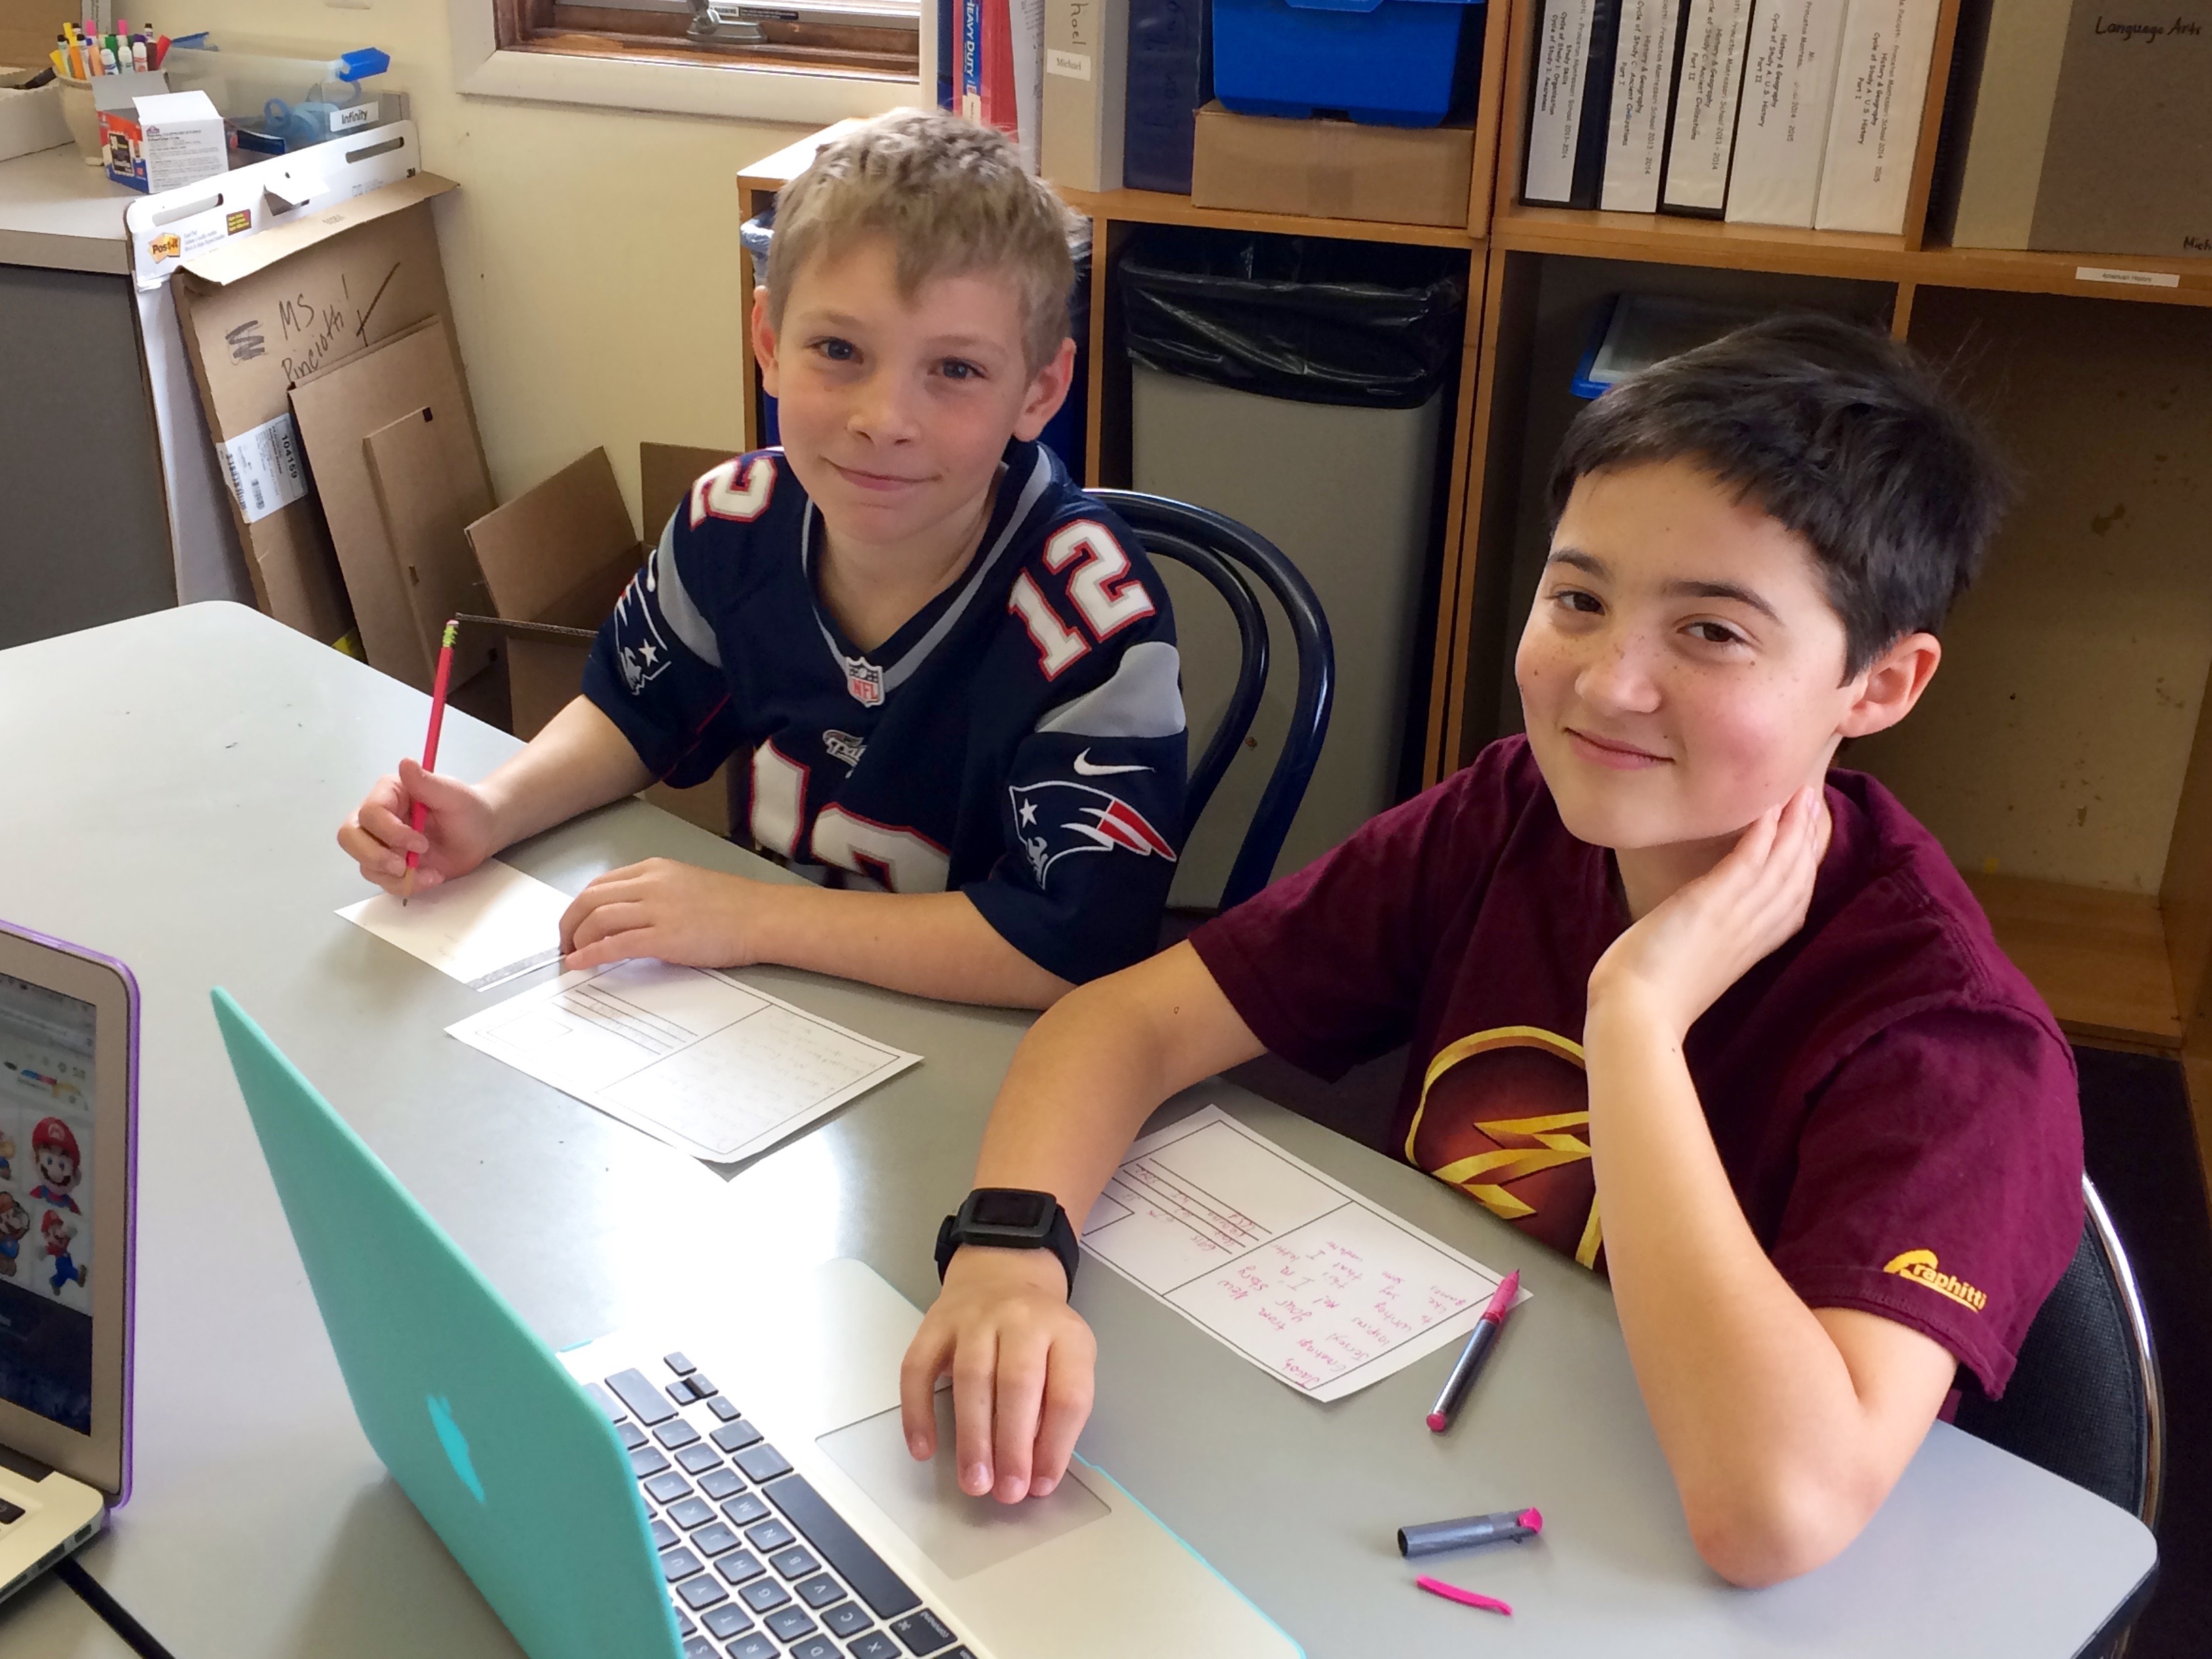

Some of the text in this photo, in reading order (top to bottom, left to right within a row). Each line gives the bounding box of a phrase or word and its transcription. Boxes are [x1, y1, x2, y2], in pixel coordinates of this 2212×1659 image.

[2095, 16, 2202, 43] Language Arts
[966, 41, 975, 77] DUTY
[342, 110, 368, 124] Infinity
[279, 293, 314, 340] MS
[1007, 519, 1158, 682] 12
[853, 680, 879, 700] NFL
[1217, 1279, 1248, 1300] New
[1258, 1307, 1286, 1330] from
[867, 1642, 882, 1654] X
